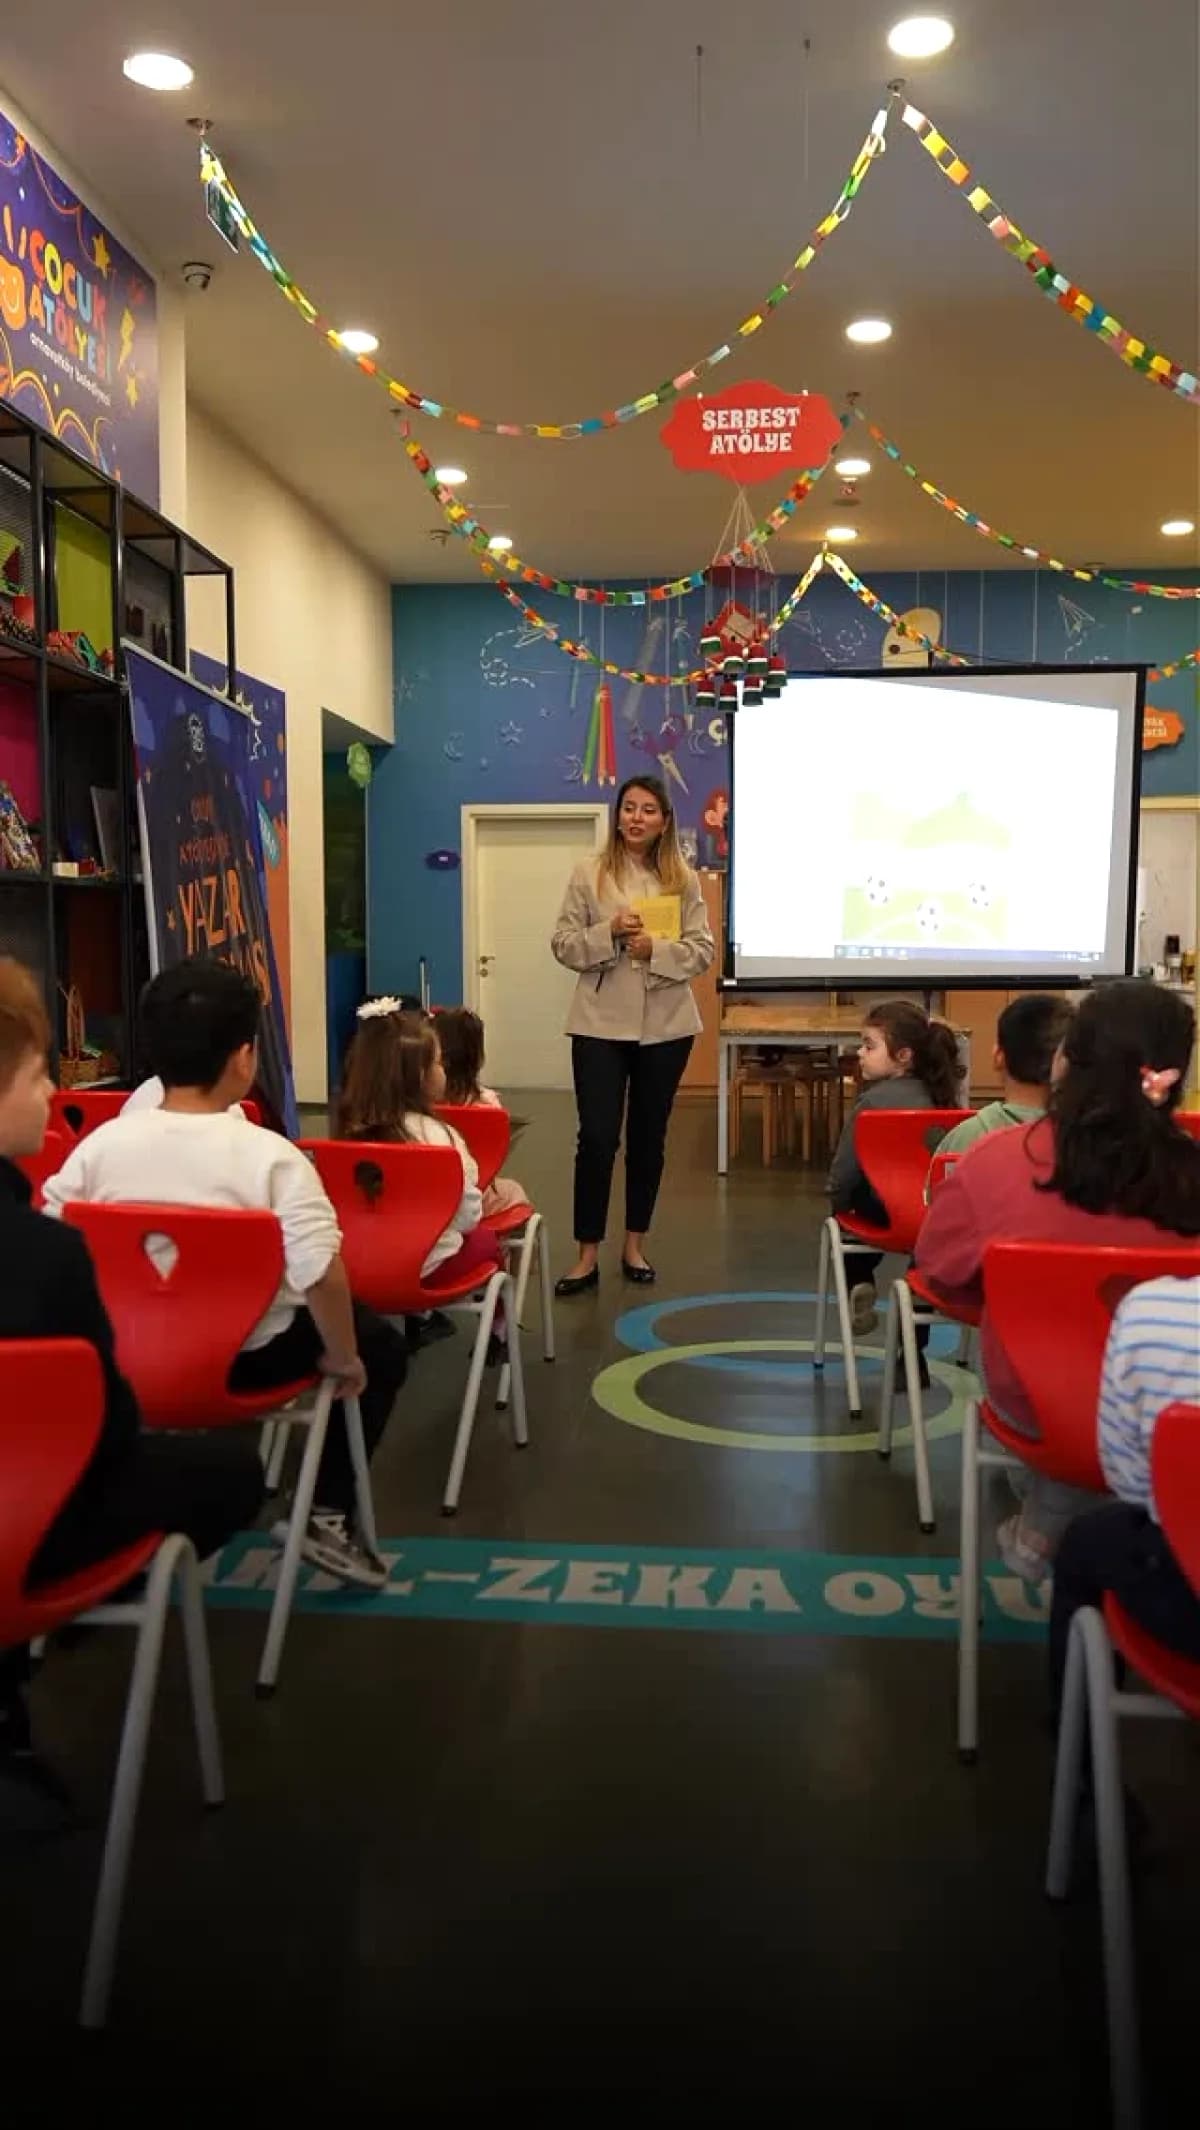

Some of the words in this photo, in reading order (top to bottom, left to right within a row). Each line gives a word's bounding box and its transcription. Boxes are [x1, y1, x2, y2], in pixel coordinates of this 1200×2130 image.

[702, 407, 800, 431] SERBEST
[710, 429, 793, 455] ATÖLYE
[178, 868, 247, 957] YAZAR
[824, 1570, 1053, 1622] OYU
